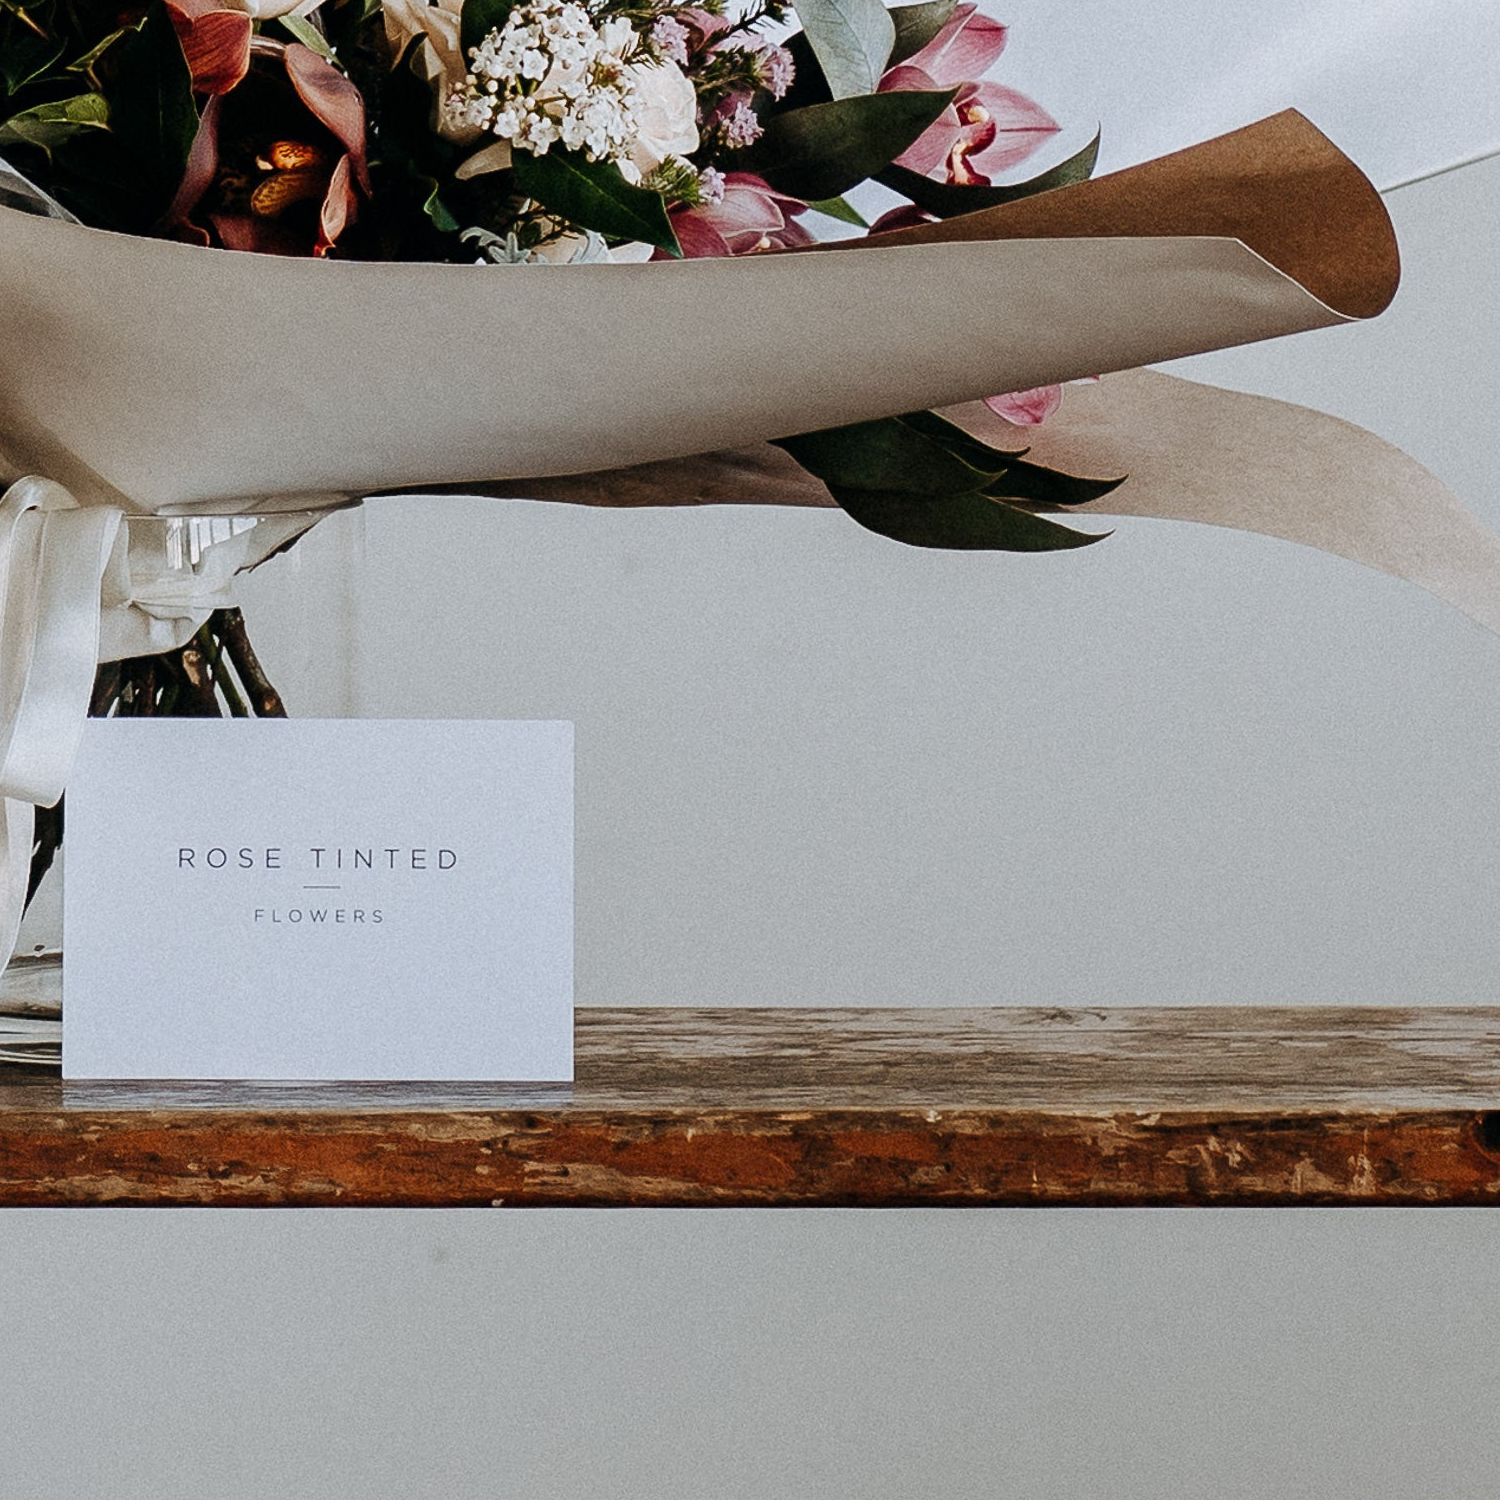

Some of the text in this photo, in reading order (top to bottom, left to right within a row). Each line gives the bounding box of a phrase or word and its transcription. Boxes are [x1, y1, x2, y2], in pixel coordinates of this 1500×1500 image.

[179, 848, 457, 870] ROSE TINTED
[254, 909, 383, 923] FLOWERS
